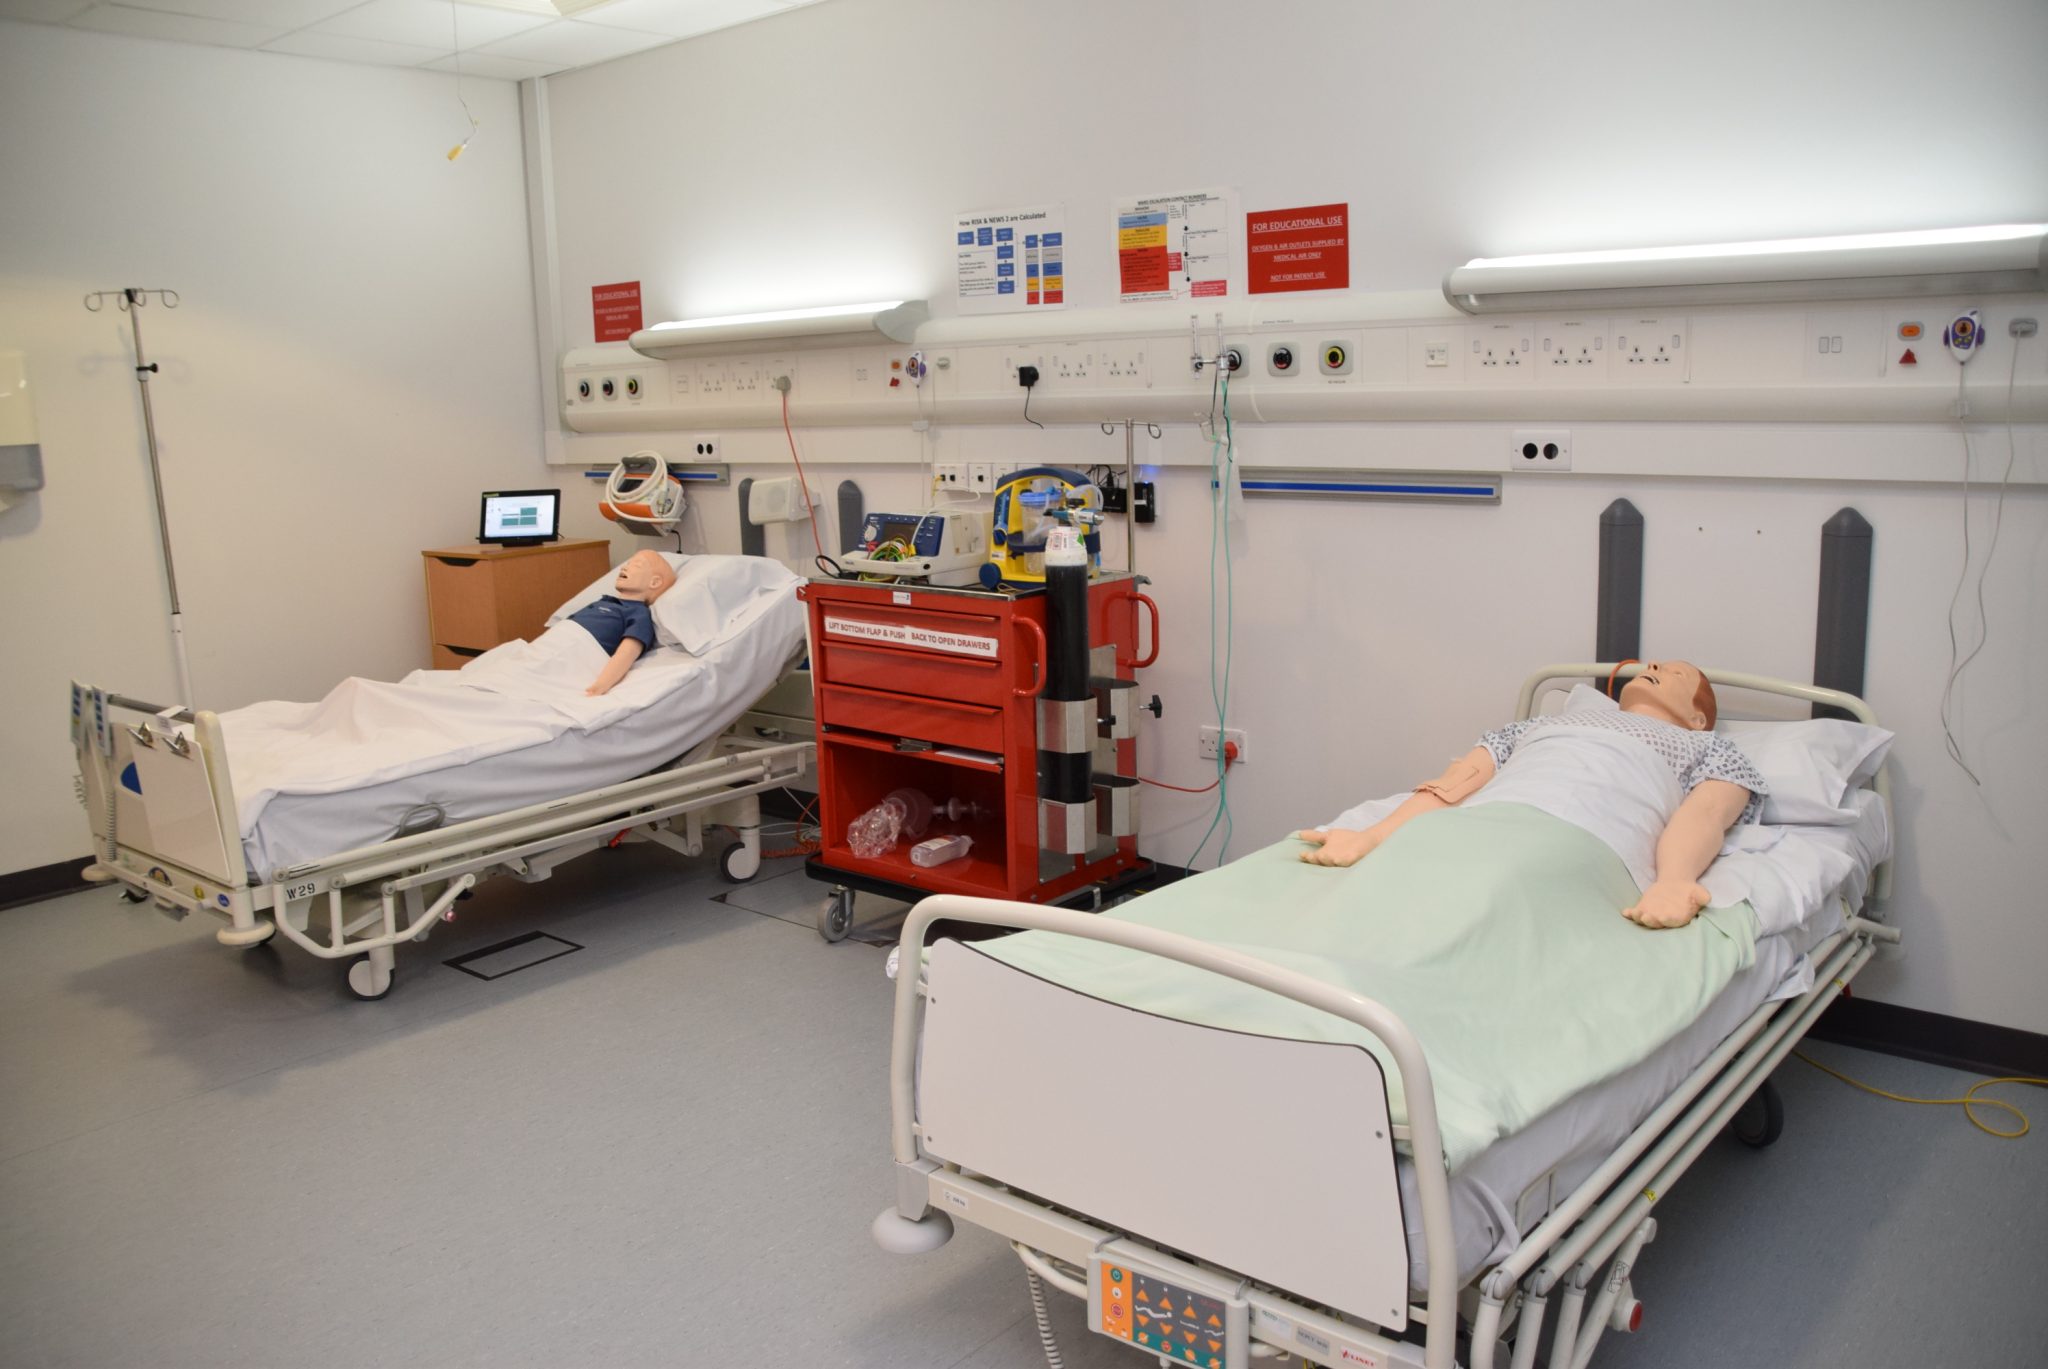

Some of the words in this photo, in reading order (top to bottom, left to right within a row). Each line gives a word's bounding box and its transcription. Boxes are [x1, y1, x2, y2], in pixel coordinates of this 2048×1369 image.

[988, 216, 1005, 224] NEWS
[1019, 212, 1046, 221] Calculated
[1252, 222, 1268, 233] FOR
[1269, 217, 1325, 231] EDUCATIONAL
[1327, 215, 1343, 226] USE
[829, 622, 840, 631] LIFT
[840, 623, 865, 635] BOTTOM
[866, 627, 882, 636] FLAP
[883, 629, 889, 637] &
[889, 630, 906, 640] PUSH
[911, 632, 927, 642] BACK
[927, 634, 937, 644] TO
[938, 636, 956, 646] OPEN
[957, 639, 990, 651] DRAWERS
[286, 882, 316, 900] W29
